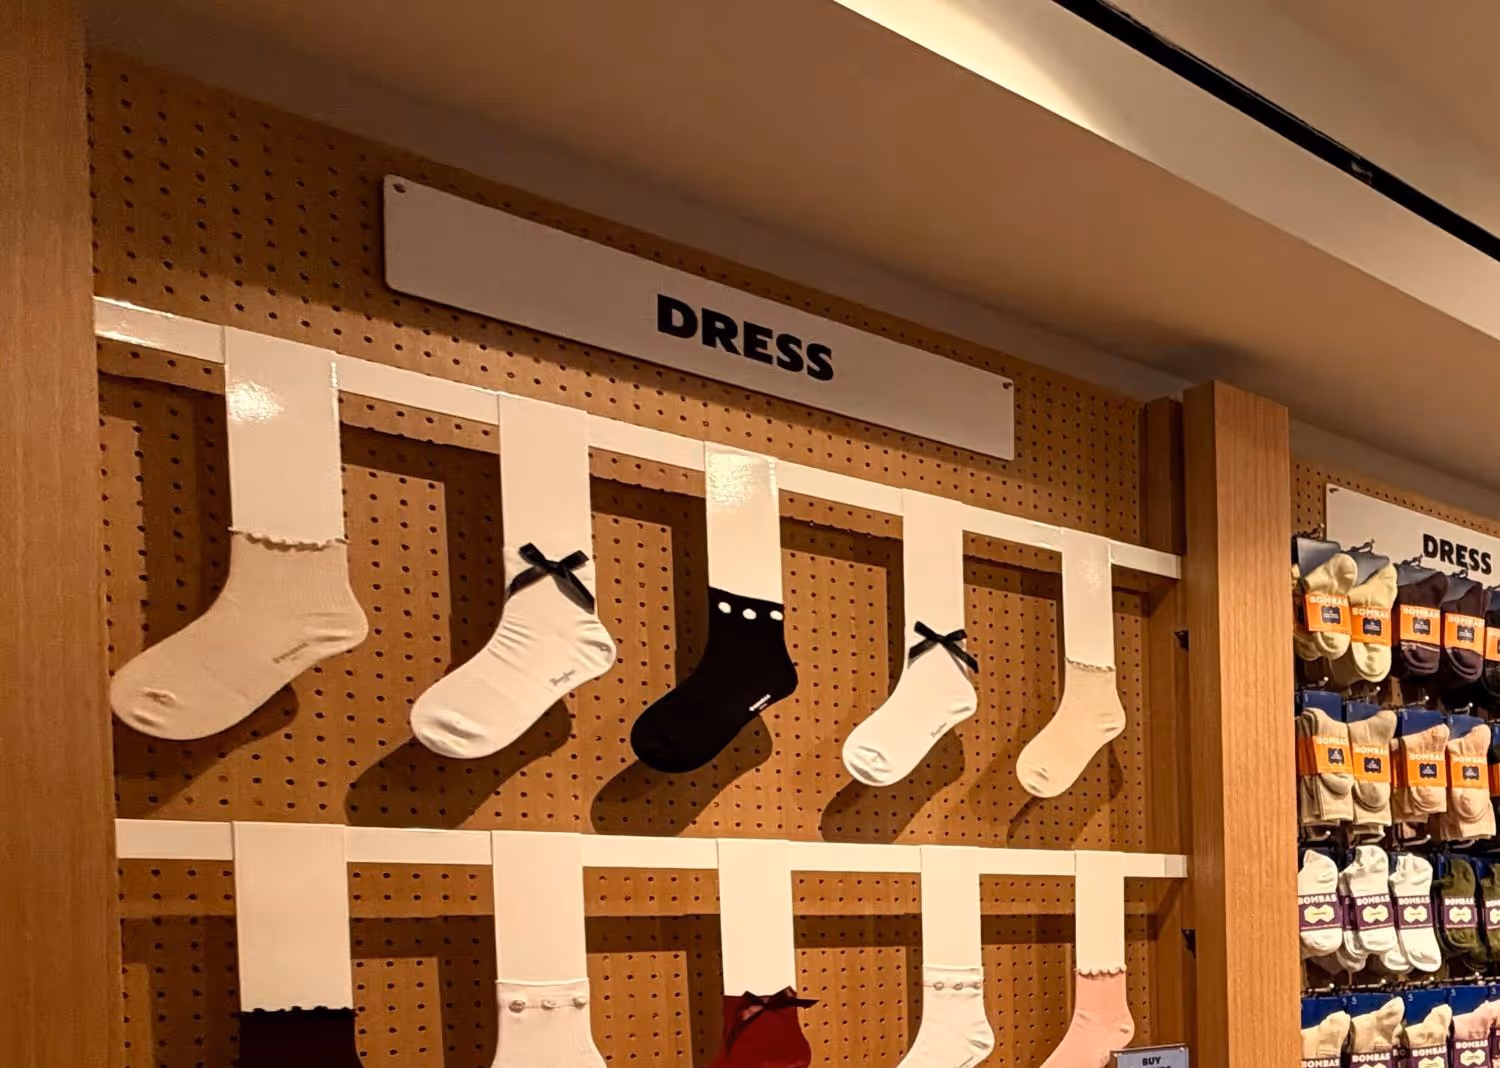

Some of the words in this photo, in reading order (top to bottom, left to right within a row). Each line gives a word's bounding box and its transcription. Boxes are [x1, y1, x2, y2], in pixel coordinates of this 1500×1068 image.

[656, 292, 834, 381] DRESS
[1423, 534, 1491, 575] DRESS
[1299, 894, 1337, 905] BOMBAS
[1357, 895, 1390, 905] BOMBAS
[1399, 896, 1430, 905] BOMBAS
[1456, 1040, 1488, 1049] BOMBAS
[1413, 1046, 1447, 1057] BOMBAS
[1142, 1056, 1161, 1066] BUY
[1352, 1052, 1390, 1062] BOMBAS
[1302, 1060, 1339, 1068] BOMBAS
